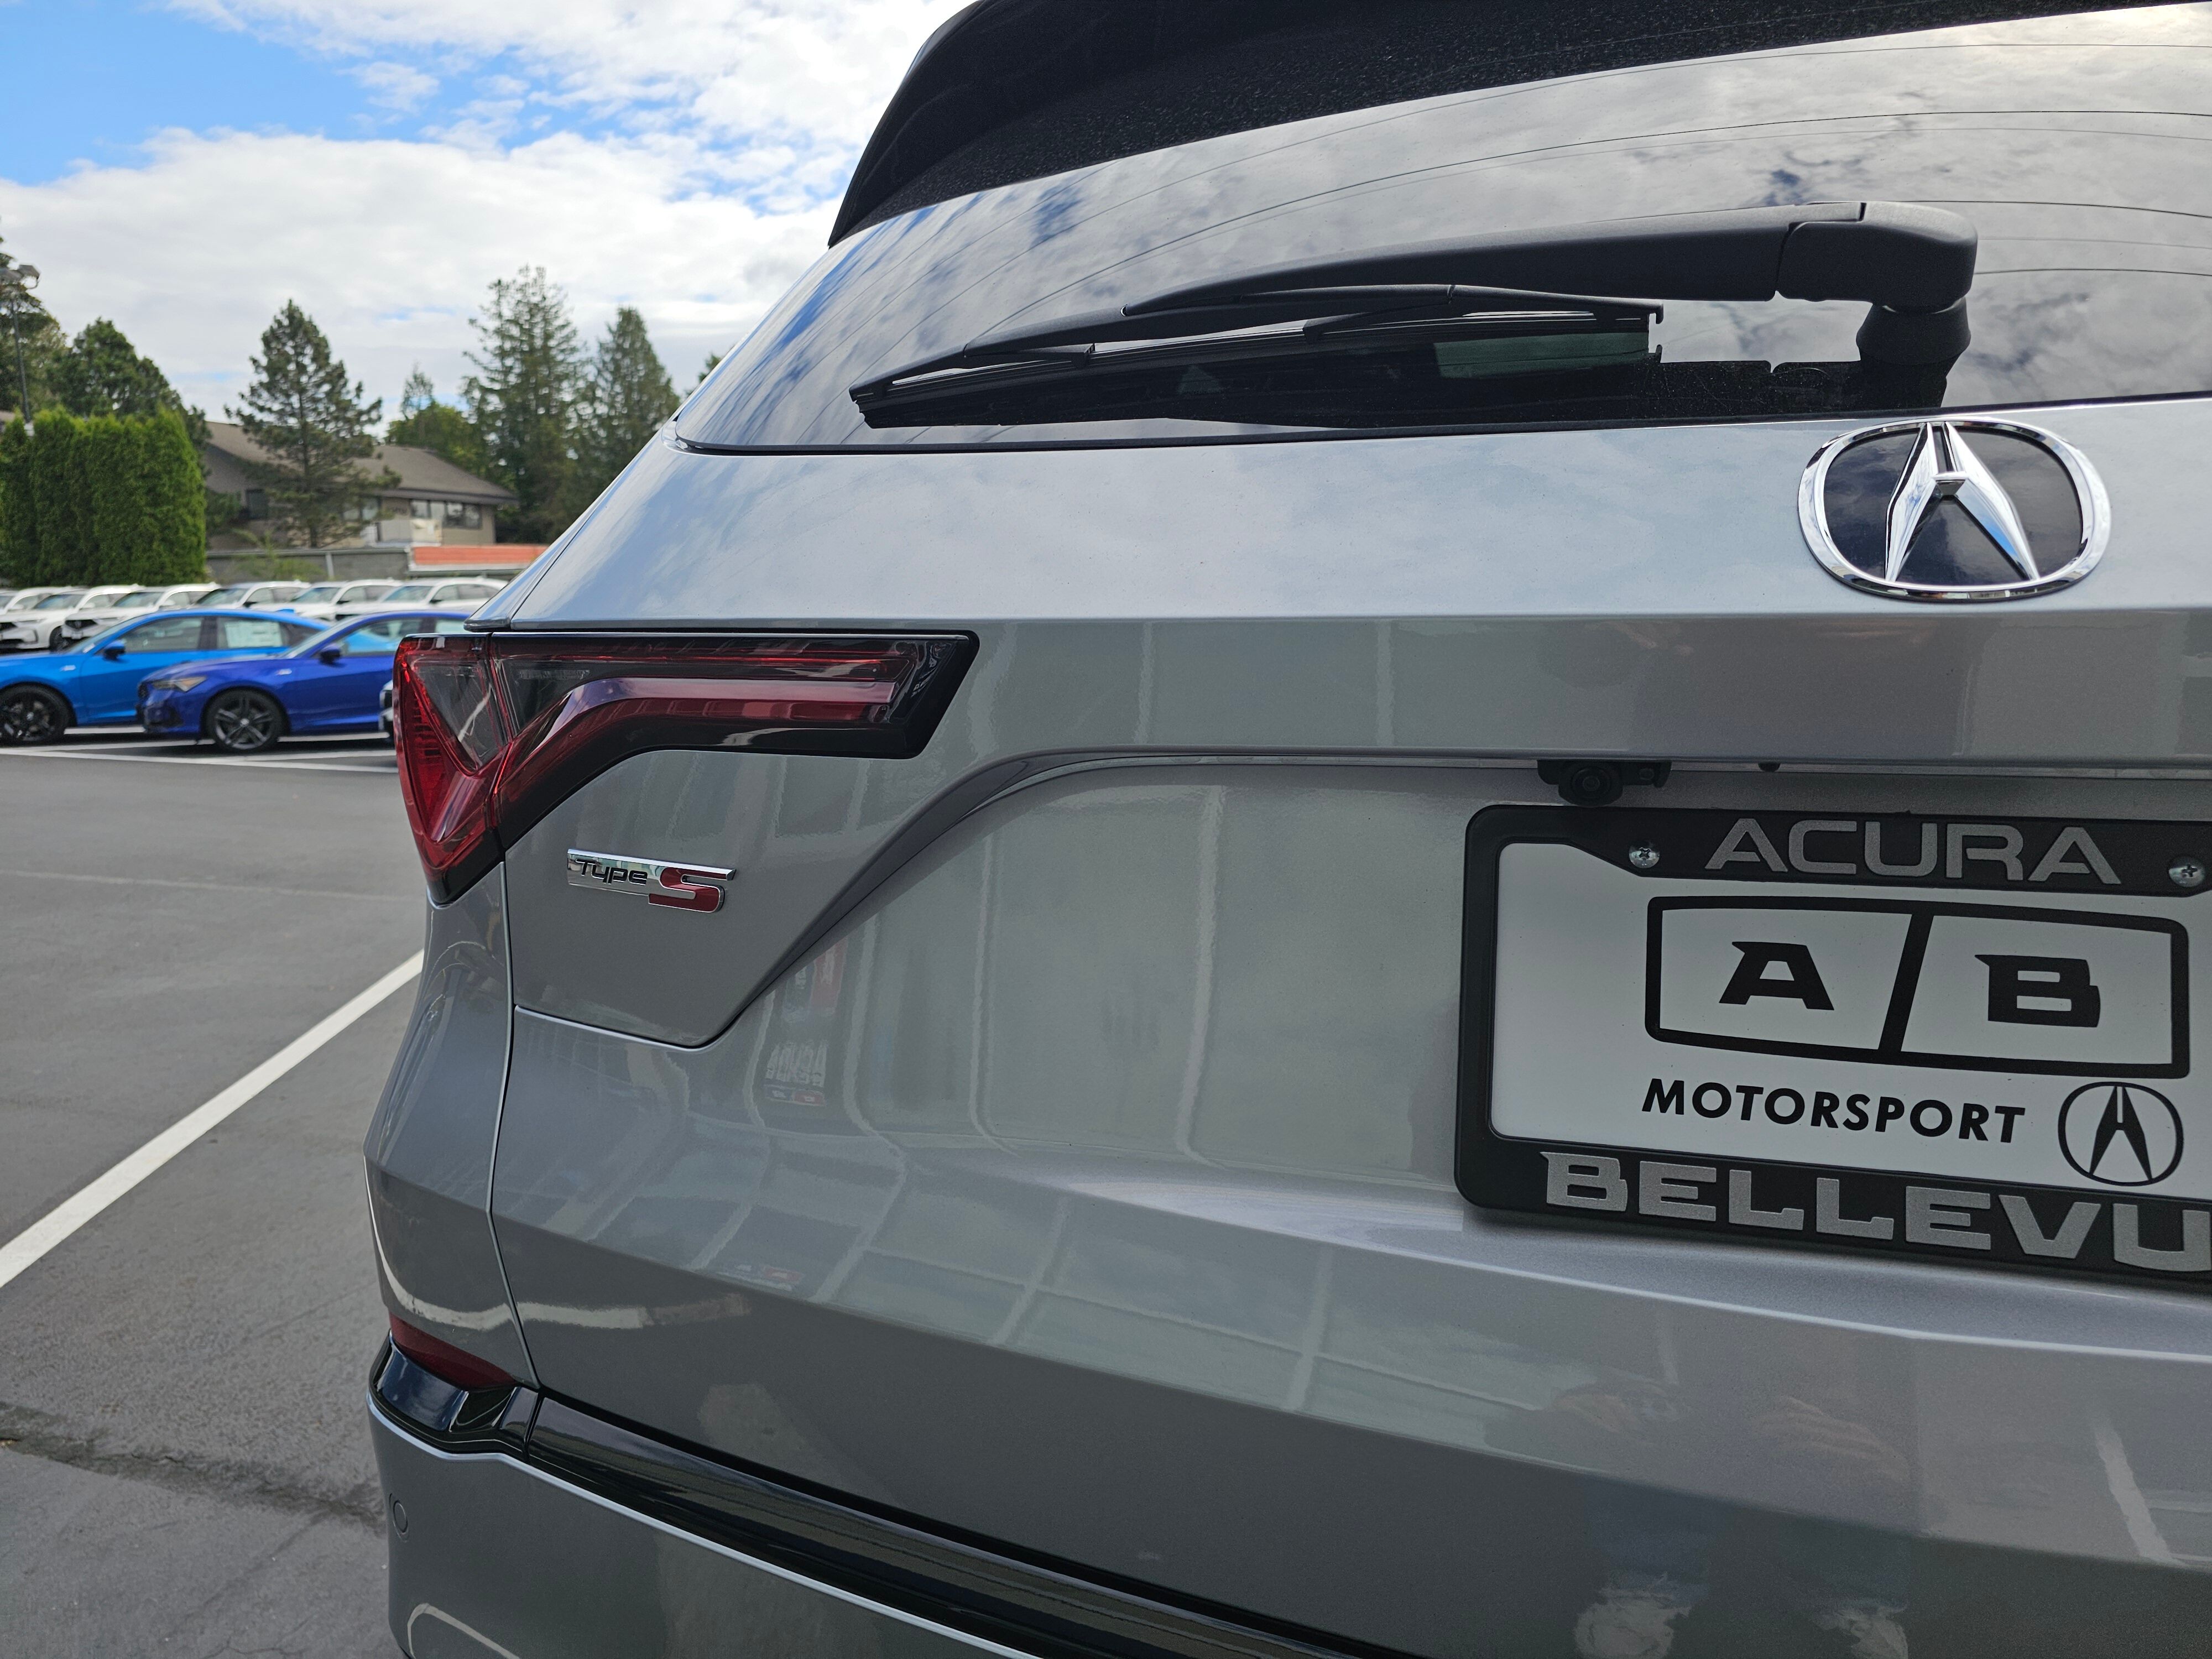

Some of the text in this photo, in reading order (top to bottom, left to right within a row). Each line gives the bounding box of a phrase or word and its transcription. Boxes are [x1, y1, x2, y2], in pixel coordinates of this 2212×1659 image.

[1704, 818, 2121, 884] ACURA
[574, 857, 737, 914] Type S
[1718, 941, 2101, 1028] A B
[1641, 1078, 2026, 1143] MOTORSPORT
[1540, 1151, 2212, 1272] BELLEVU
